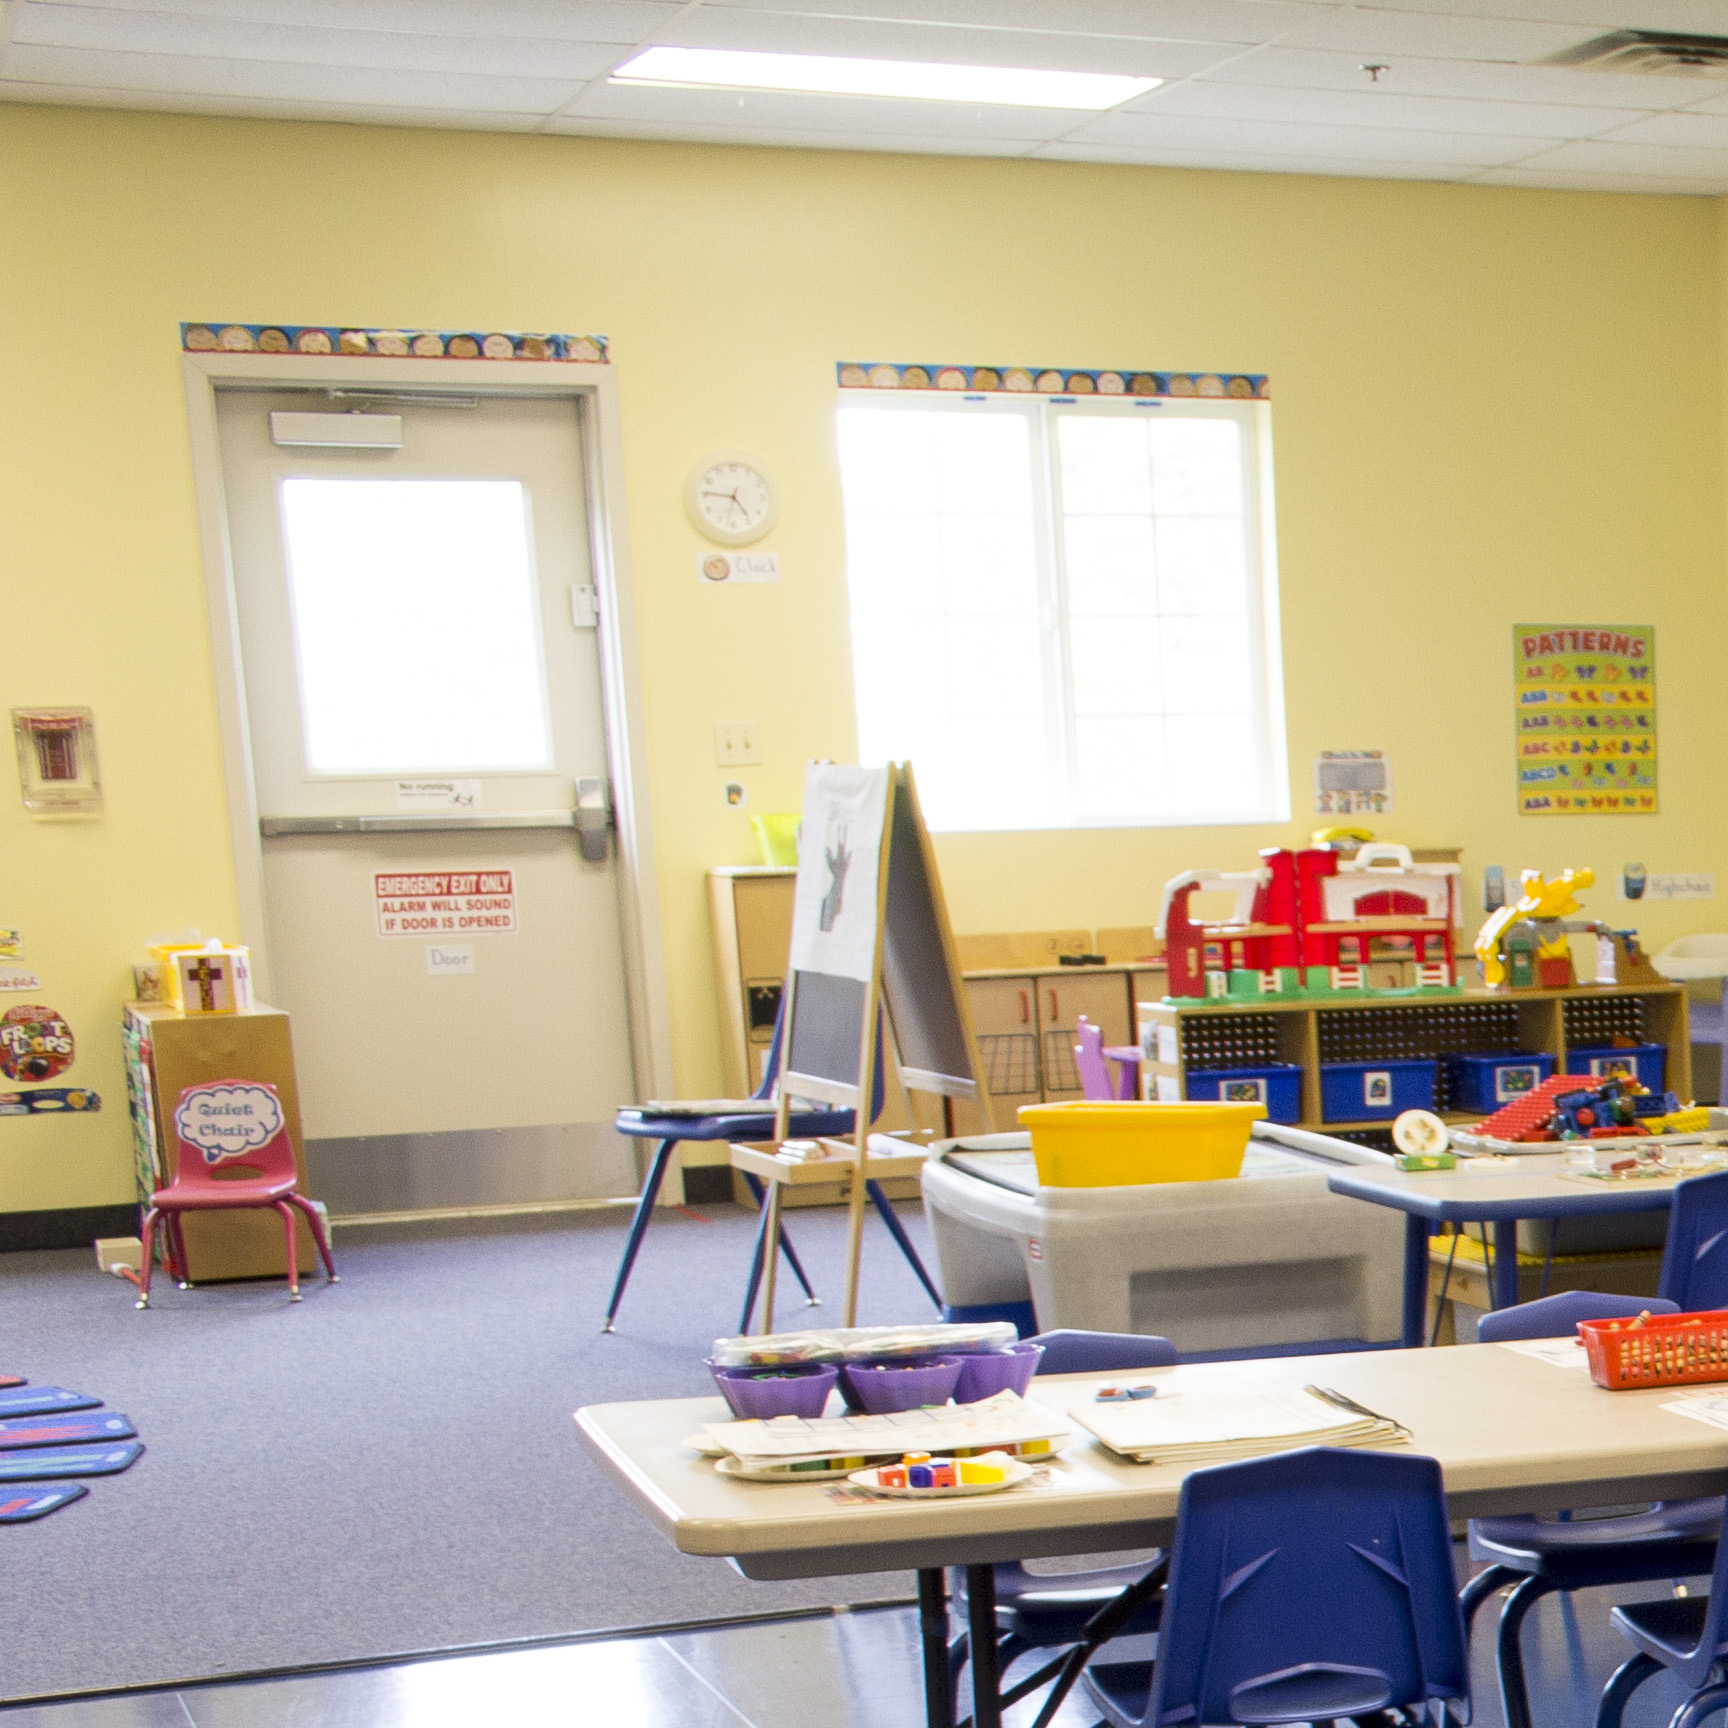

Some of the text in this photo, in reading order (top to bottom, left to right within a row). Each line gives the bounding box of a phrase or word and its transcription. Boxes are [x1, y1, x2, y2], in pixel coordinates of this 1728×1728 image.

[1521, 629, 1645, 661] PATTERNS
[379, 873, 511, 896] EMERGENCY EXIT ONLY
[382, 899, 511, 914] ALARM WILL SOUND
[385, 915, 511, 930] IF DOOR IS OPENED
[430, 948, 470, 966] Door
[12, 1034, 73, 1056] LOOPS
[198, 1102, 254, 1117] Quiet
[198, 1123, 255, 1139] Chair
